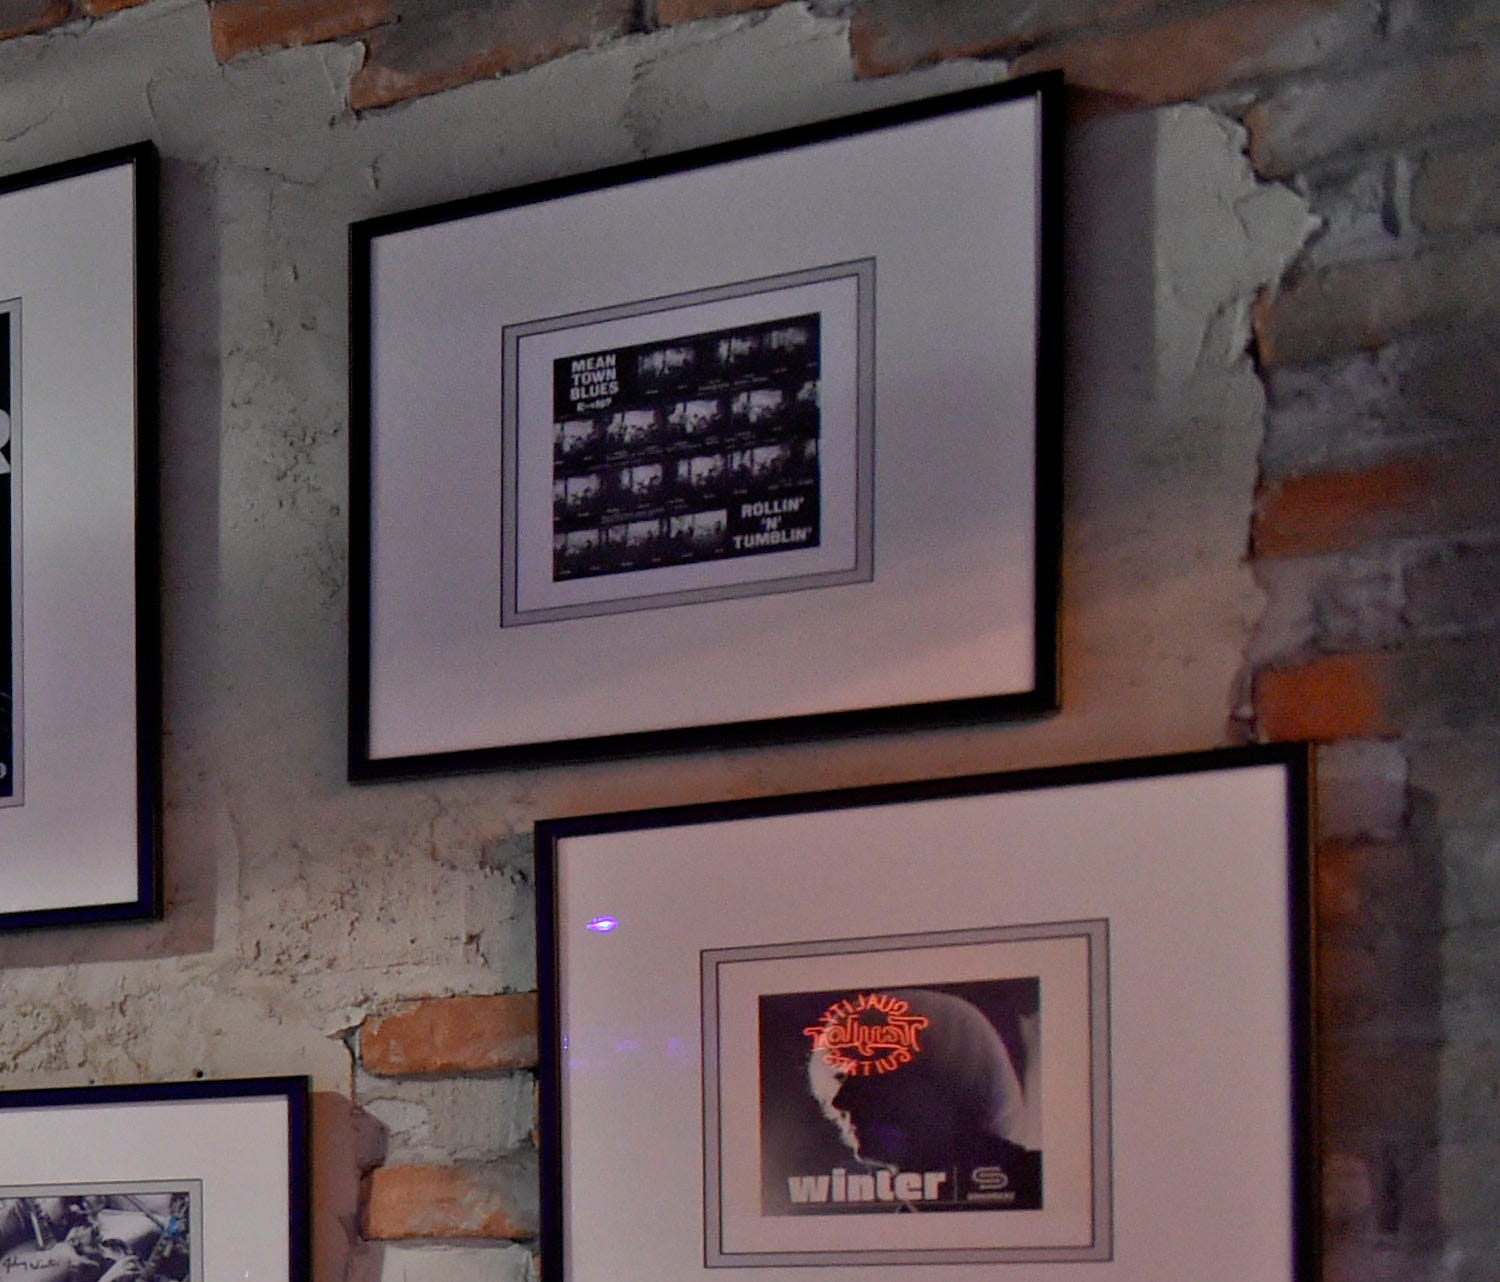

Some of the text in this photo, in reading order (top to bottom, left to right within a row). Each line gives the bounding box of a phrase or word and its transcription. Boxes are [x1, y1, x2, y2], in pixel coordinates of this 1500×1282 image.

[572, 354, 617, 373] MEAN
[572, 368, 617, 386] TOWN
[570, 381, 620, 401] BLUES
[741, 496, 805, 518] ROLLIN'
[732, 526, 813, 551] TUMBLIN'
[788, 1168, 946, 1203] winter
